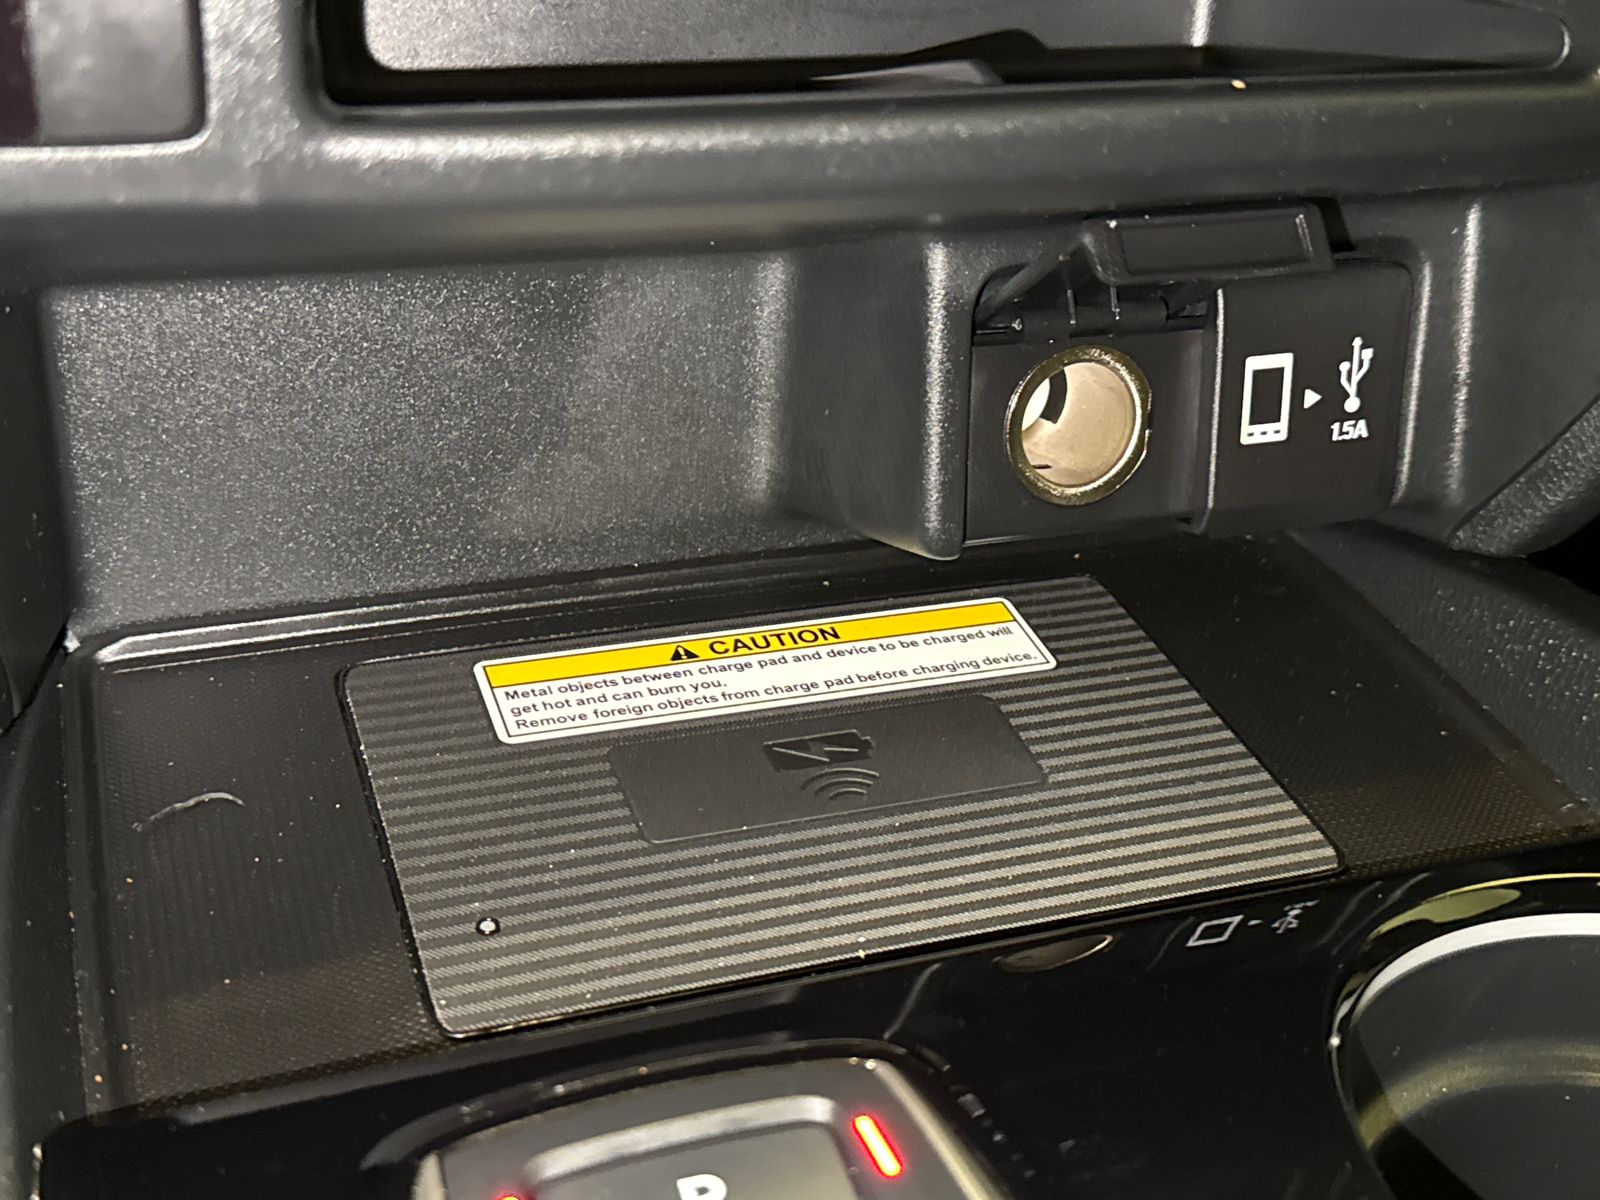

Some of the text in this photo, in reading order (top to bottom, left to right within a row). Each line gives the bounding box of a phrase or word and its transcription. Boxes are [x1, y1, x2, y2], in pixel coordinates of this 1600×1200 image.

[504, 626, 1013, 700] Metal objects between charge pad and device to be charged will
[708, 626, 841, 655] CAUTION
[511, 679, 728, 717] get hot and can burn you.
[515, 651, 1037, 730] Remove foreign objects from charge pad before charging device.
